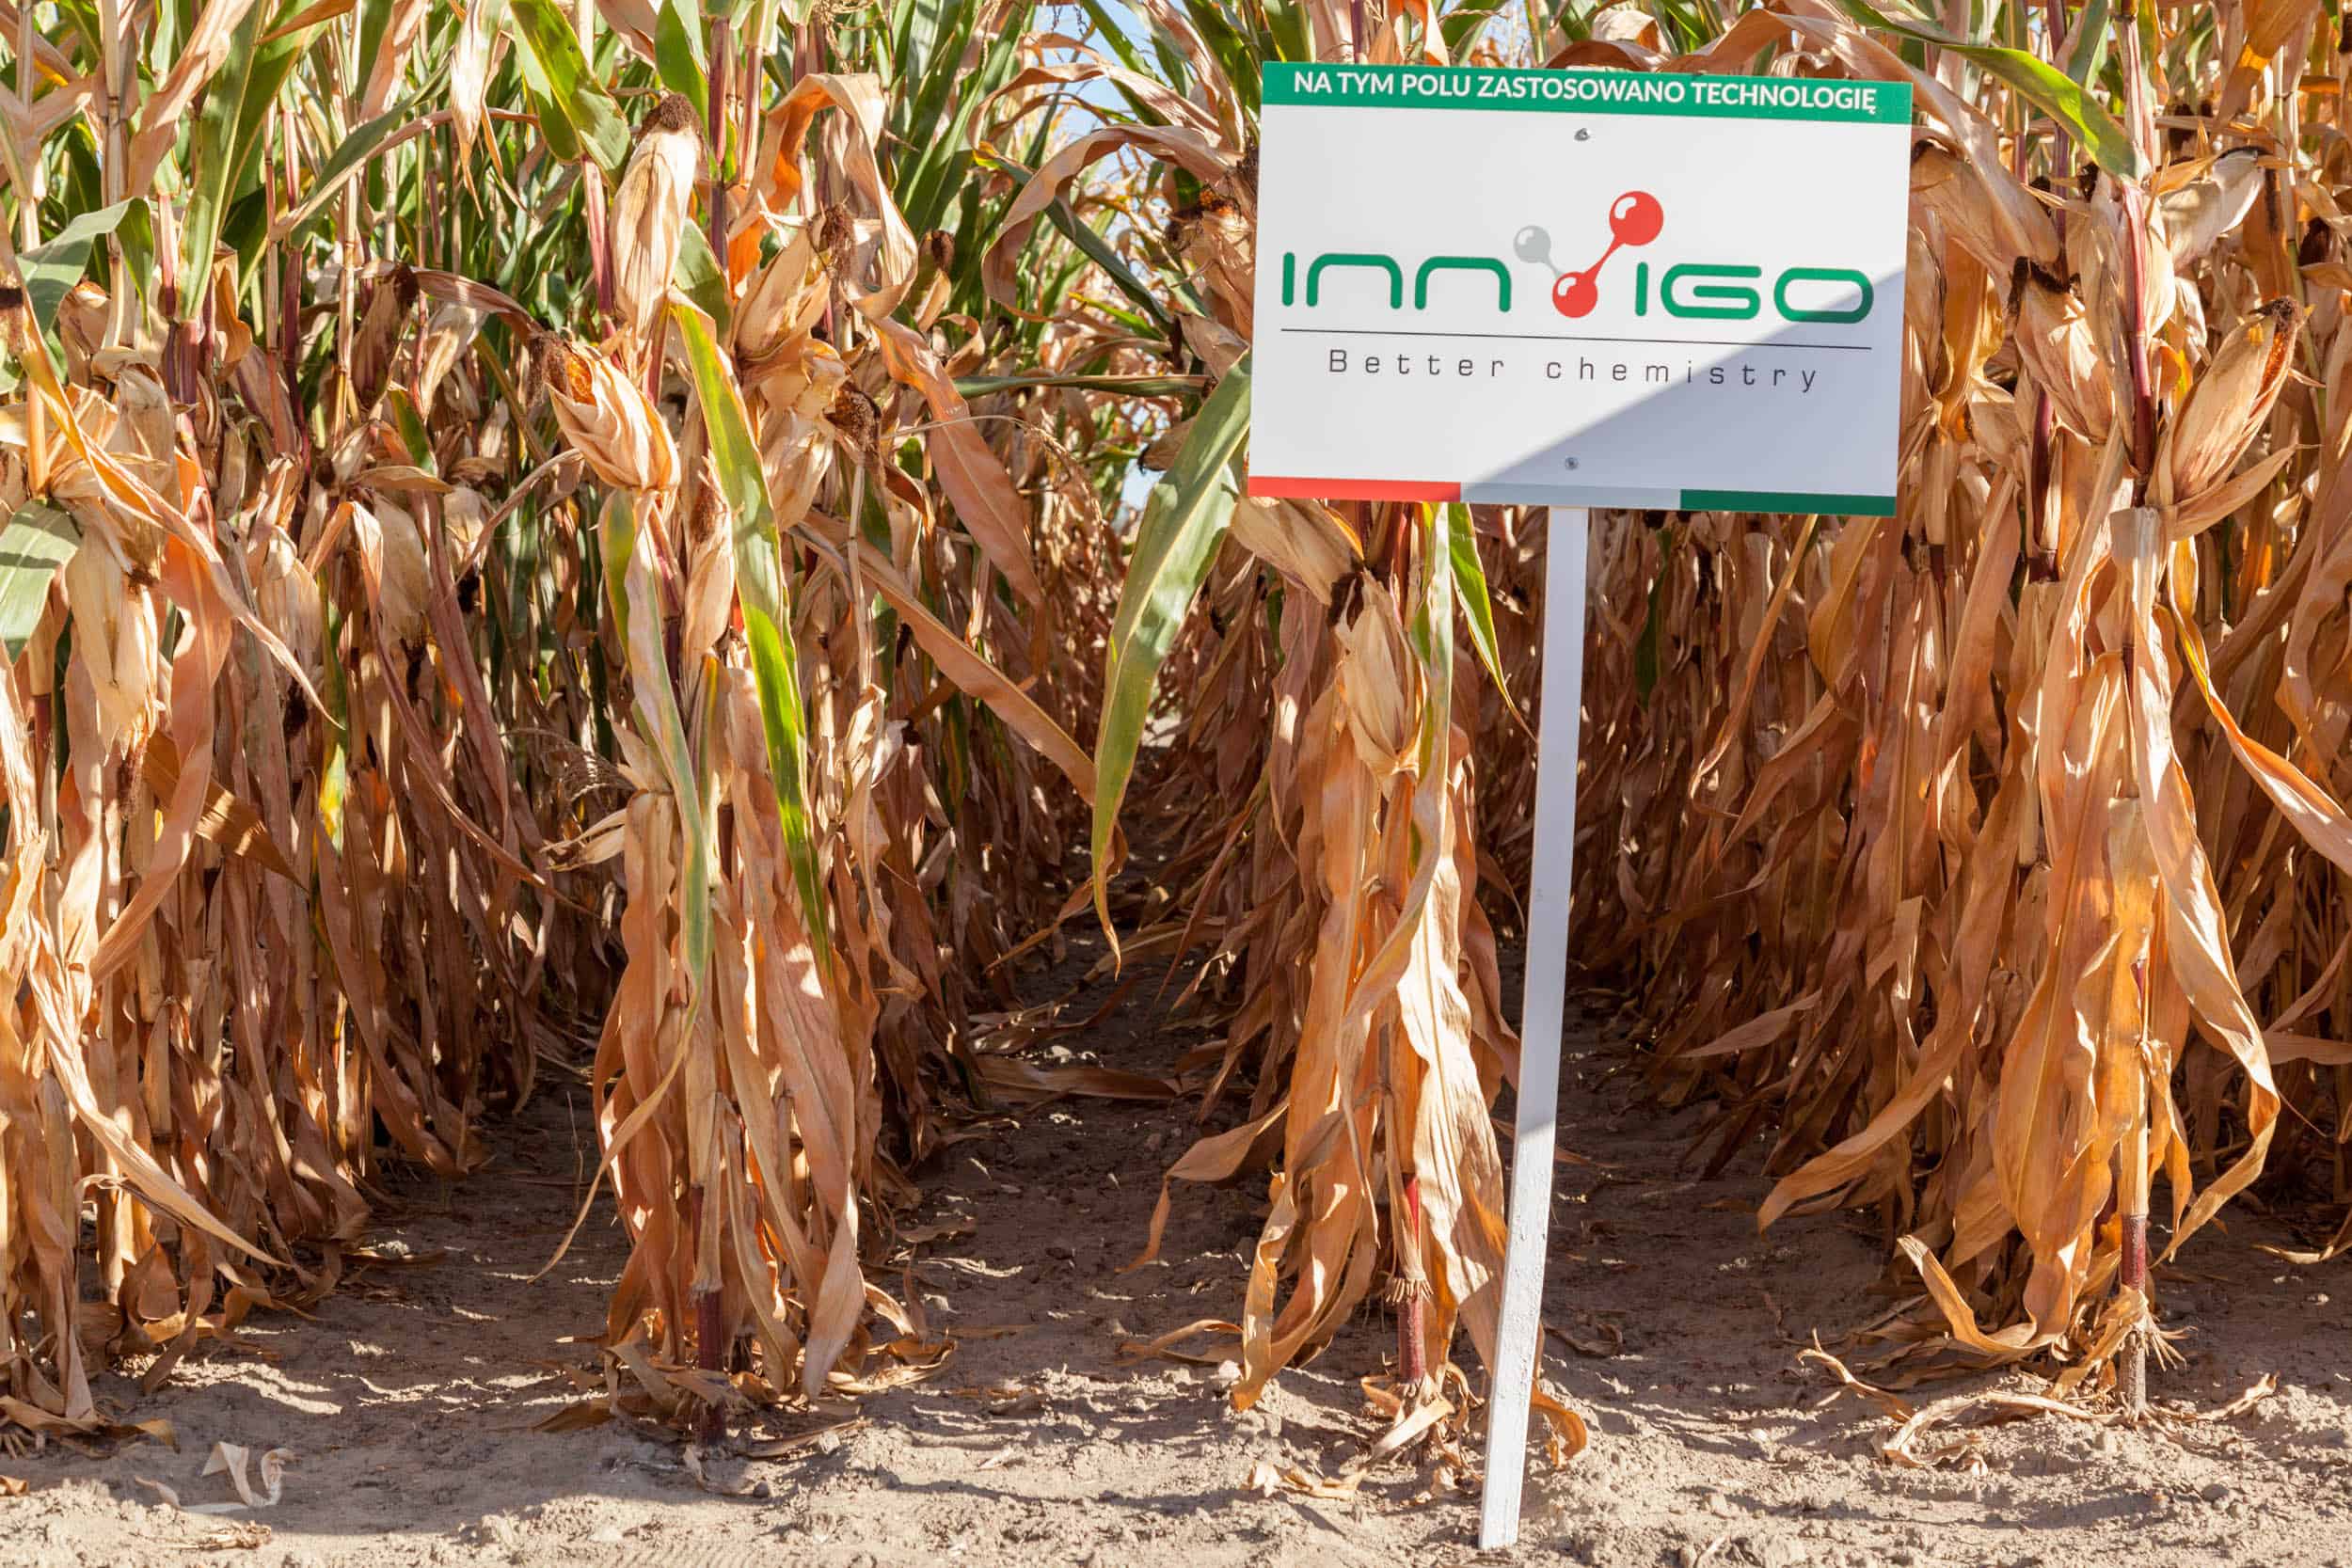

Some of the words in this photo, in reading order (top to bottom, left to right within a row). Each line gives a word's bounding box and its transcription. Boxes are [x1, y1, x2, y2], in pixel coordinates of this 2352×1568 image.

[1294, 71, 1332, 93] NA
[1337, 71, 1394, 94] TYM
[1401, 73, 1471, 97] POLU
[1477, 75, 1685, 103] ZASTOSOWANO
[1690, 81, 1878, 115] TECHNOLOGIĘ
[1328, 349, 1505, 378] Better
[1546, 358, 1817, 393] chemistry
